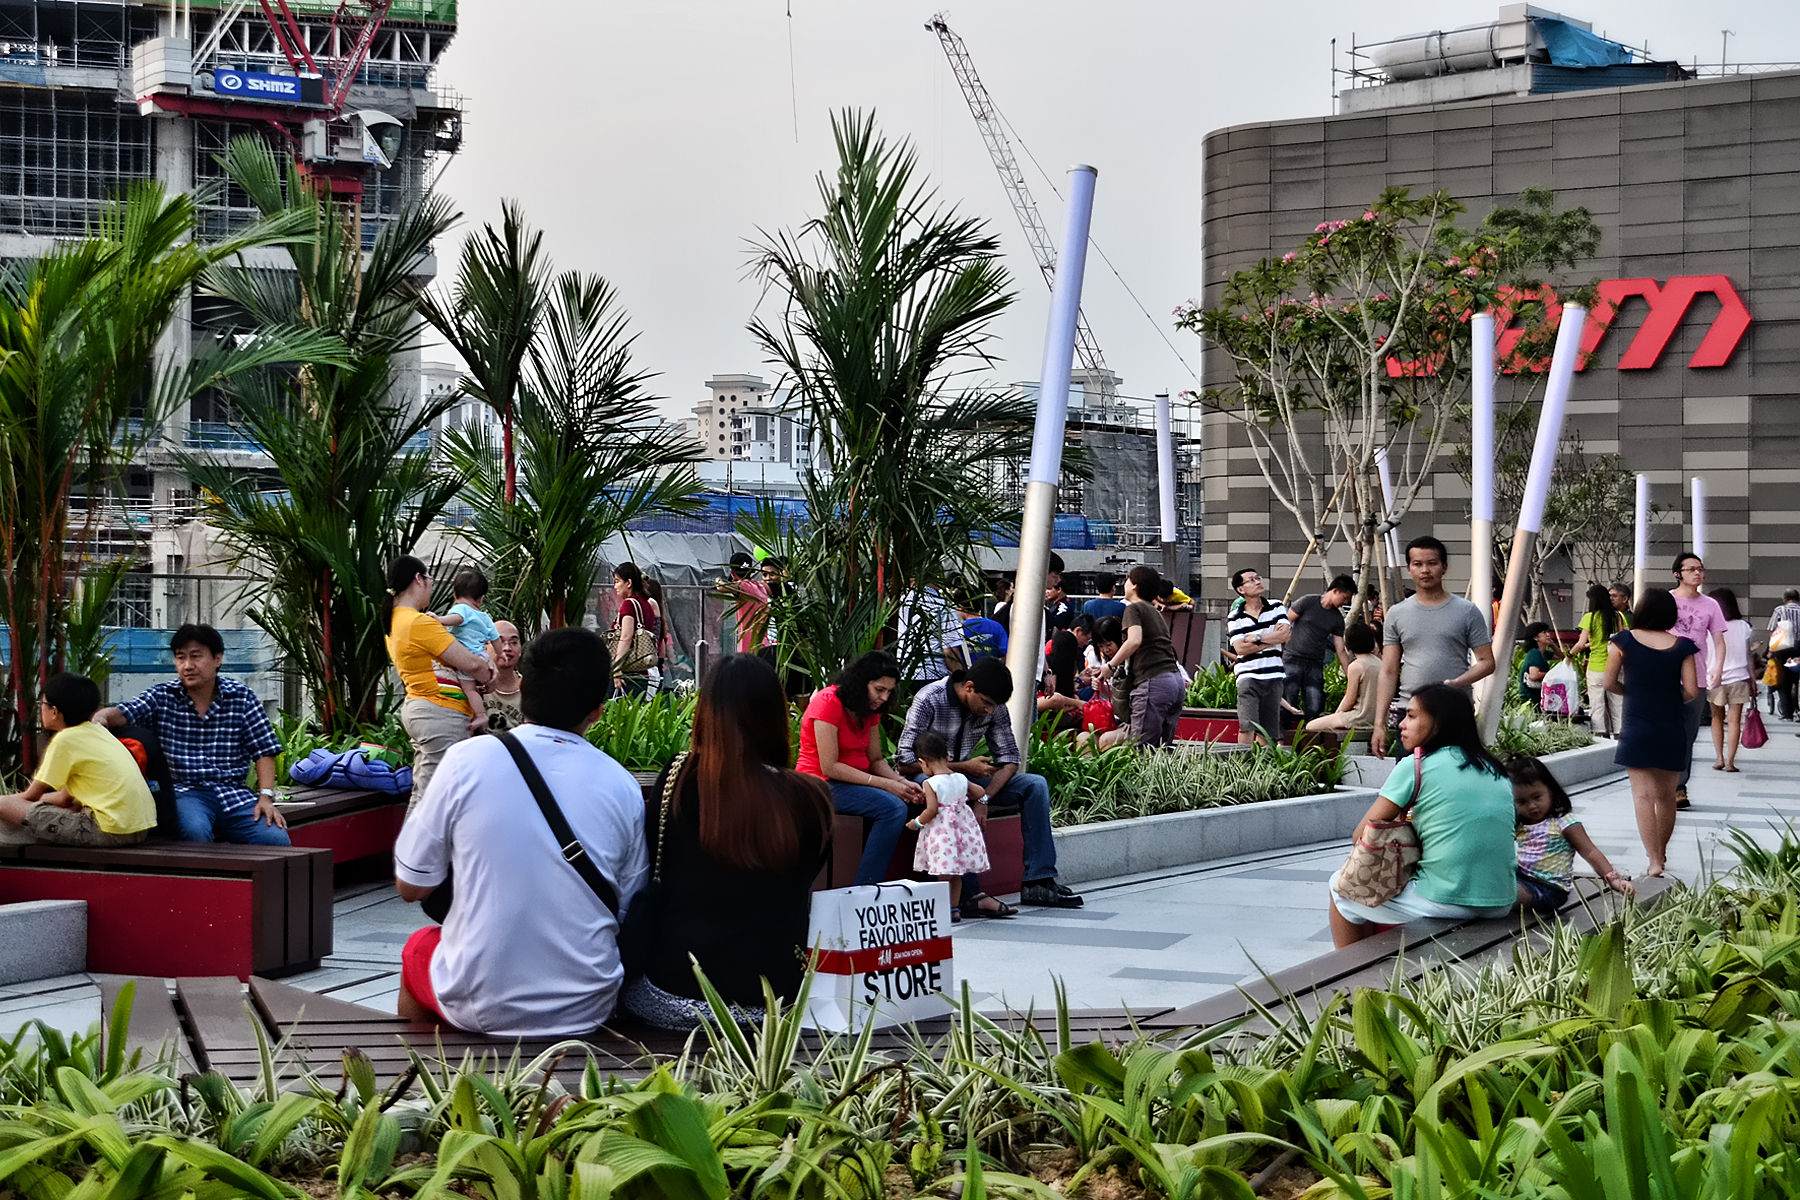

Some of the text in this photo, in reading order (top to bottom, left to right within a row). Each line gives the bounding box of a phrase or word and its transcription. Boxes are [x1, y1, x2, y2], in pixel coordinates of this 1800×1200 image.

[855, 898, 935, 928] YOUR NEW
[859, 920, 938, 950] FAVOURITE
[863, 961, 942, 1006] STORE
